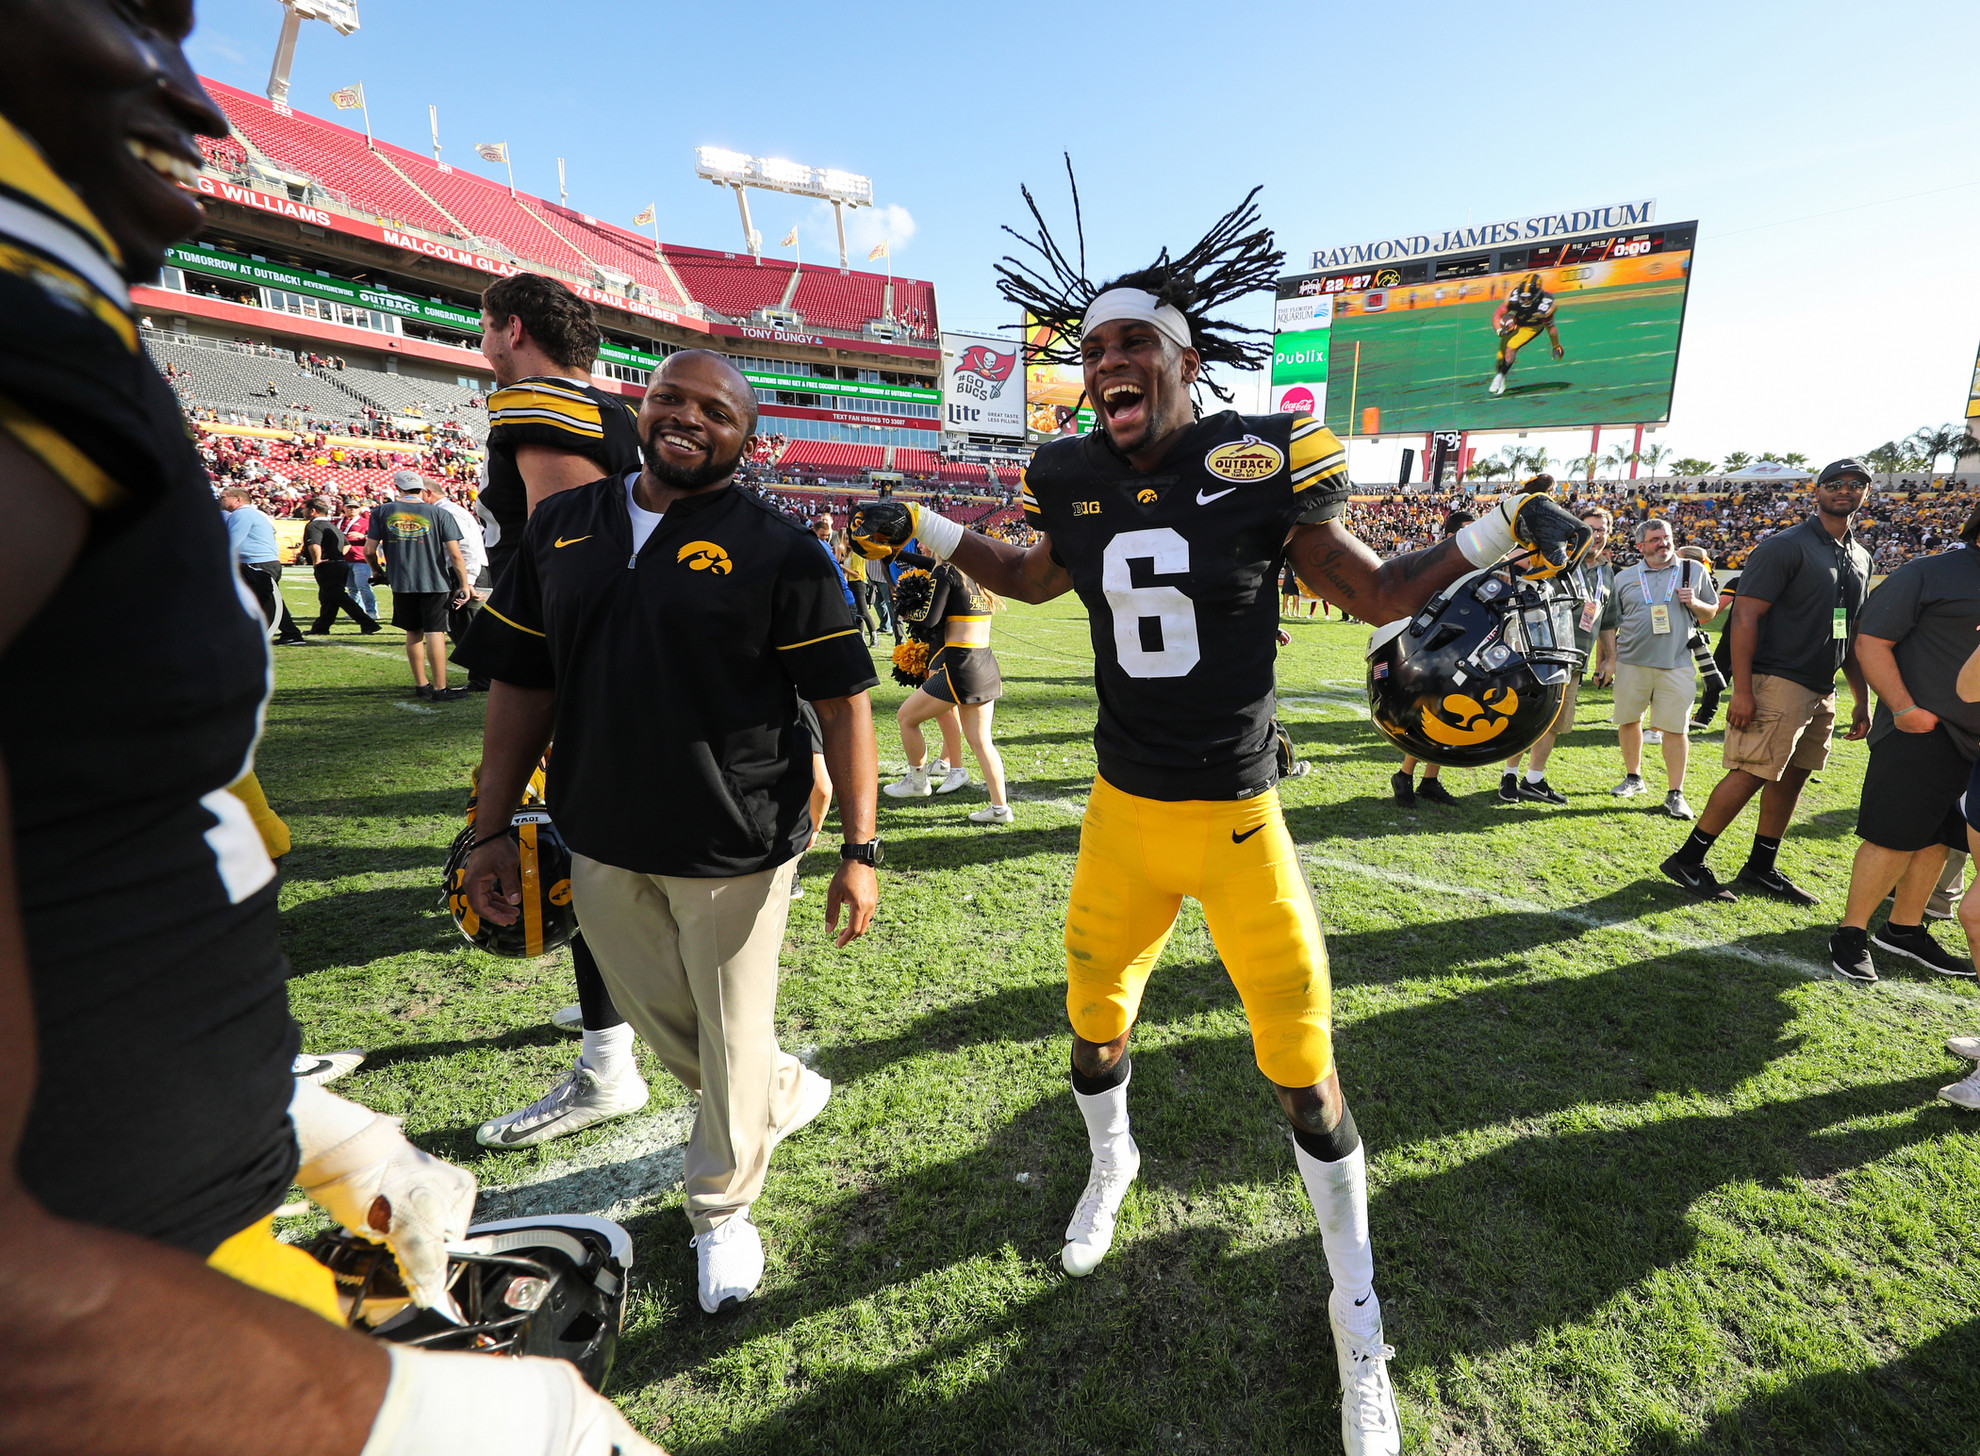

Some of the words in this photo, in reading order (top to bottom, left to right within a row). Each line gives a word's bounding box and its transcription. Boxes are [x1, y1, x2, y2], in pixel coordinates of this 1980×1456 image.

[220, 183, 331, 226] WILLIAMS
[1311, 235, 1430, 269] RAYMOND
[1433, 220, 1519, 252] JAMES
[1523, 202, 1650, 239] STADIUM
[383, 229, 473, 266] MALCOLM
[1614, 241, 1651, 257] 0:00
[176, 249, 238, 272] TOMORROW
[240, 264, 252, 275] AT
[253, 267, 301, 286] OUTBACK!
[1325, 278, 1344, 292] 22
[1352, 274, 1372, 289] 27
[359, 293, 421, 314] OUTBACK
[574, 284, 590, 299] 74
[592, 290, 627, 310] PAUL
[628, 301, 679, 323] GRUBER
[1277, 310, 1314, 324] AQUARIUM
[741, 327, 772, 340] TONY
[774, 331, 814, 344] DUNGY
[958, 374, 984, 389] #GO
[956, 382, 988, 401] BUCS
[833, 413, 848, 421] TEXT
[848, 414, 860, 422] FAN
[947, 403, 981, 425] Lite
[1215, 459, 1273, 469] OUTBACK
[1103, 527, 1200, 678] 6
[513, 815, 539, 824] IOWA
